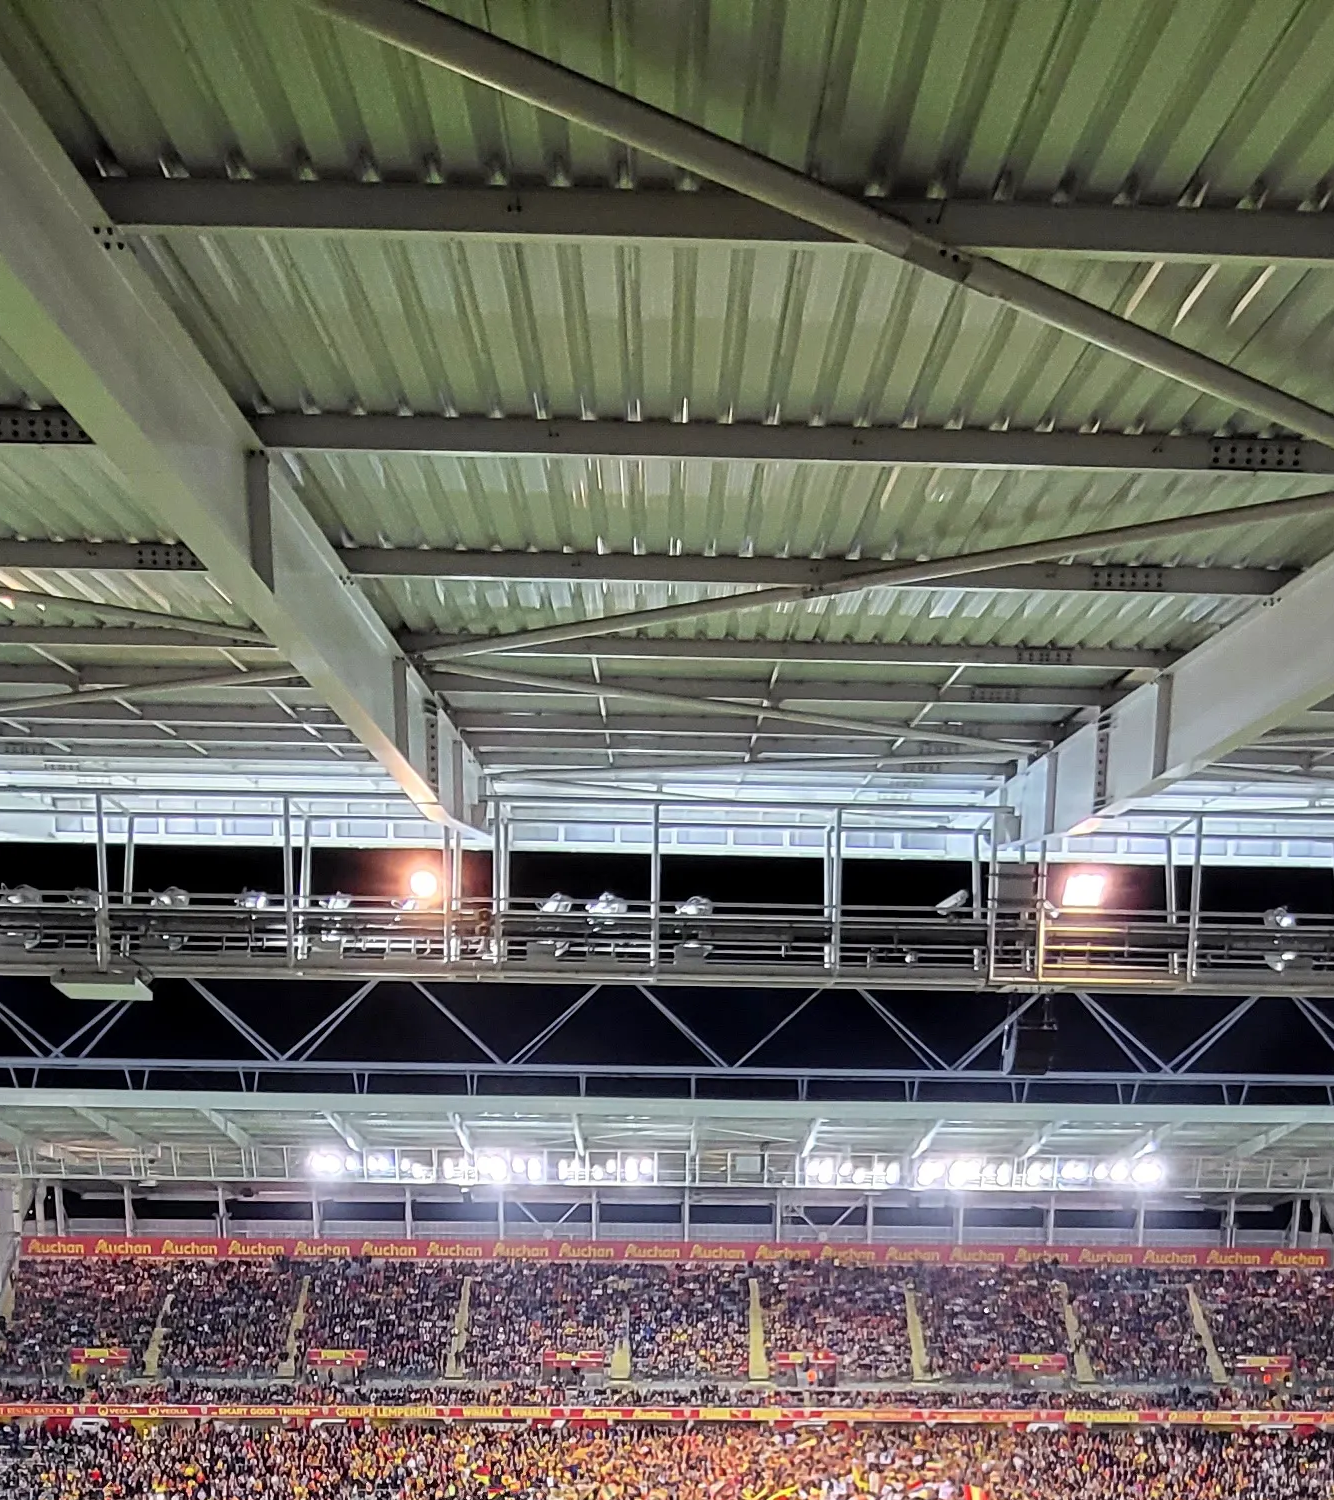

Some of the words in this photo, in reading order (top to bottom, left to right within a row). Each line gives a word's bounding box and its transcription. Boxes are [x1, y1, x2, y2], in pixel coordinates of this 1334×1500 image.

[28, 1239, 84, 1254] Auchan
[95, 1239, 151, 1254] Auchan
[161, 1240, 217, 1255] Auchan
[228, 1240, 284, 1256] Auchan
[294, 1241, 350, 1256] Auchan
[361, 1241, 416, 1256] Auchan
[427, 1241, 482, 1256] Auchan
[493, 1242, 548, 1257] Auchan
[559, 1242, 613, 1257] Auchan
[625, 1243, 680, 1258] Auchan
[690, 1244, 745, 1259] Auchan
[950, 1247, 1004, 1262] Auchan
[1143, 1249, 1197, 1264] Auchan
[1207, 1249, 1260, 1264] Auchan
[1270, 1250, 1324, 1265] Auchan
[278, 1408, 310, 1416] THINGS
[335, 1407, 374, 1417] GROUPE
[377, 1407, 436, 1417] LEMPEREUR
